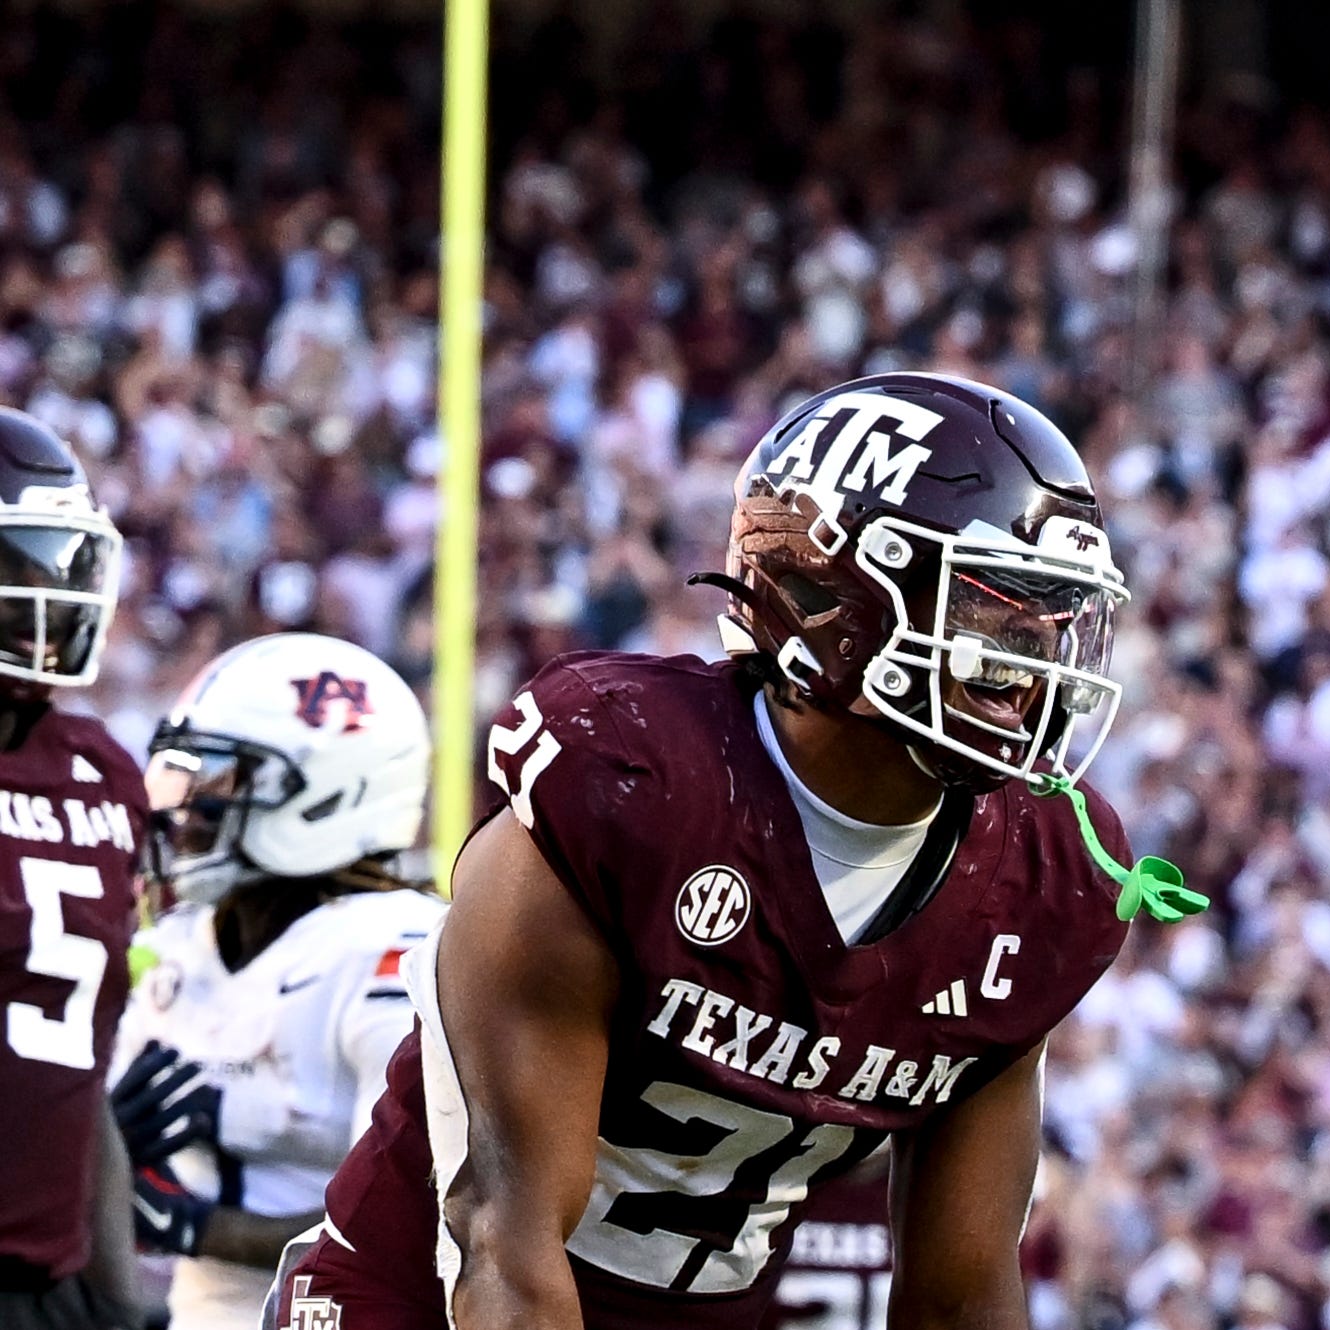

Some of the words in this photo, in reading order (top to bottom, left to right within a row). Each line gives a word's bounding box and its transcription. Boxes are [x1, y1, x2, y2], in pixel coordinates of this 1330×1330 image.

[488, 691, 562, 830] 21
[5, 856, 108, 1070] 5
[677, 866, 750, 944] SEC
[980, 934, 1021, 1000] C
[647, 978, 841, 1090] TEXAS
[837, 1044, 978, 1106] A&M
[564, 1081, 855, 1293] 21
